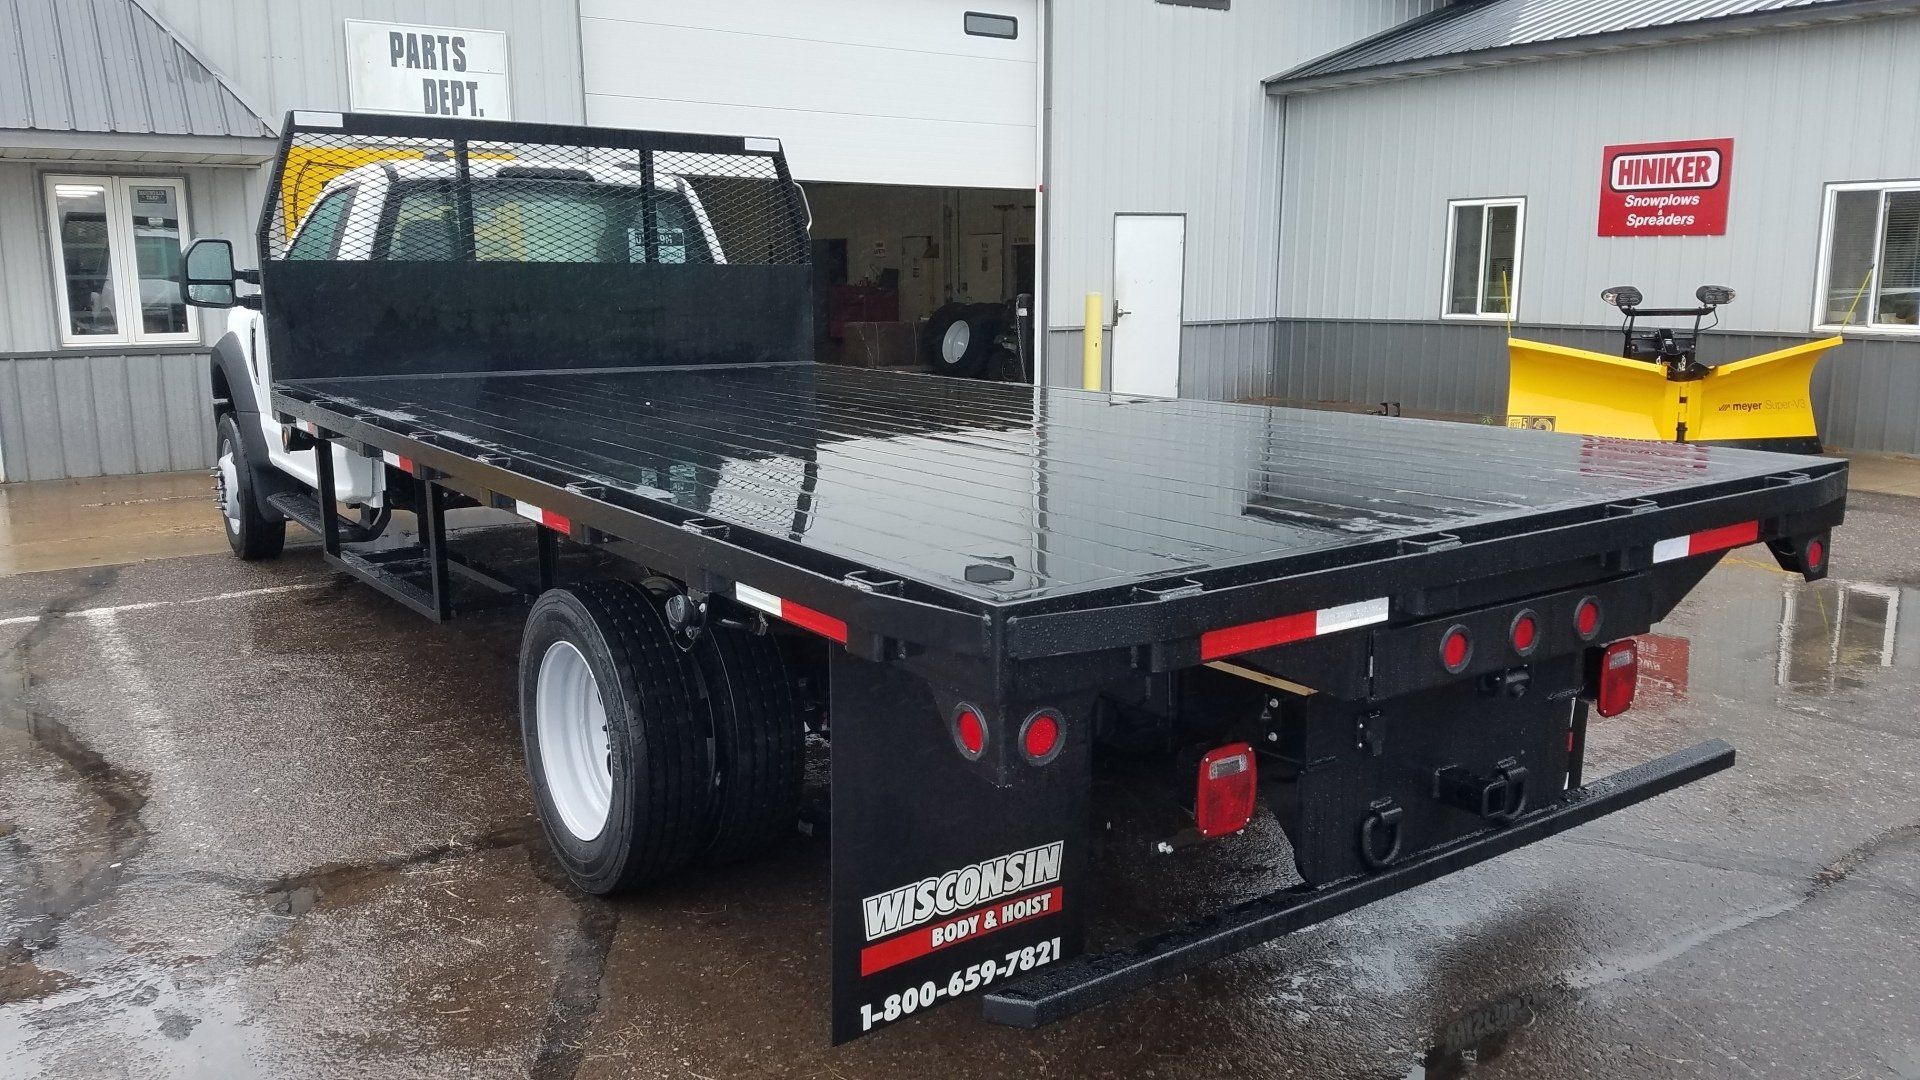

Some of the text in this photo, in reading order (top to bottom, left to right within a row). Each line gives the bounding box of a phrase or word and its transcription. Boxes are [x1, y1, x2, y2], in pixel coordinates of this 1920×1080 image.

[389, 31, 467, 73] PARTS
[422, 78, 485, 117] DEPT.
[1617, 155, 1712, 186] HINIKER
[1624, 194, 1700, 208] Snowplows
[1626, 213, 1695, 228] Spreaders
[1732, 399, 1806, 412] meyer Super-V3
[863, 840, 1064, 941] WISCONSIN
[932, 893, 1052, 948] BODY & HOIST
[860, 937, 1061, 1032] 1-800-659-7821
